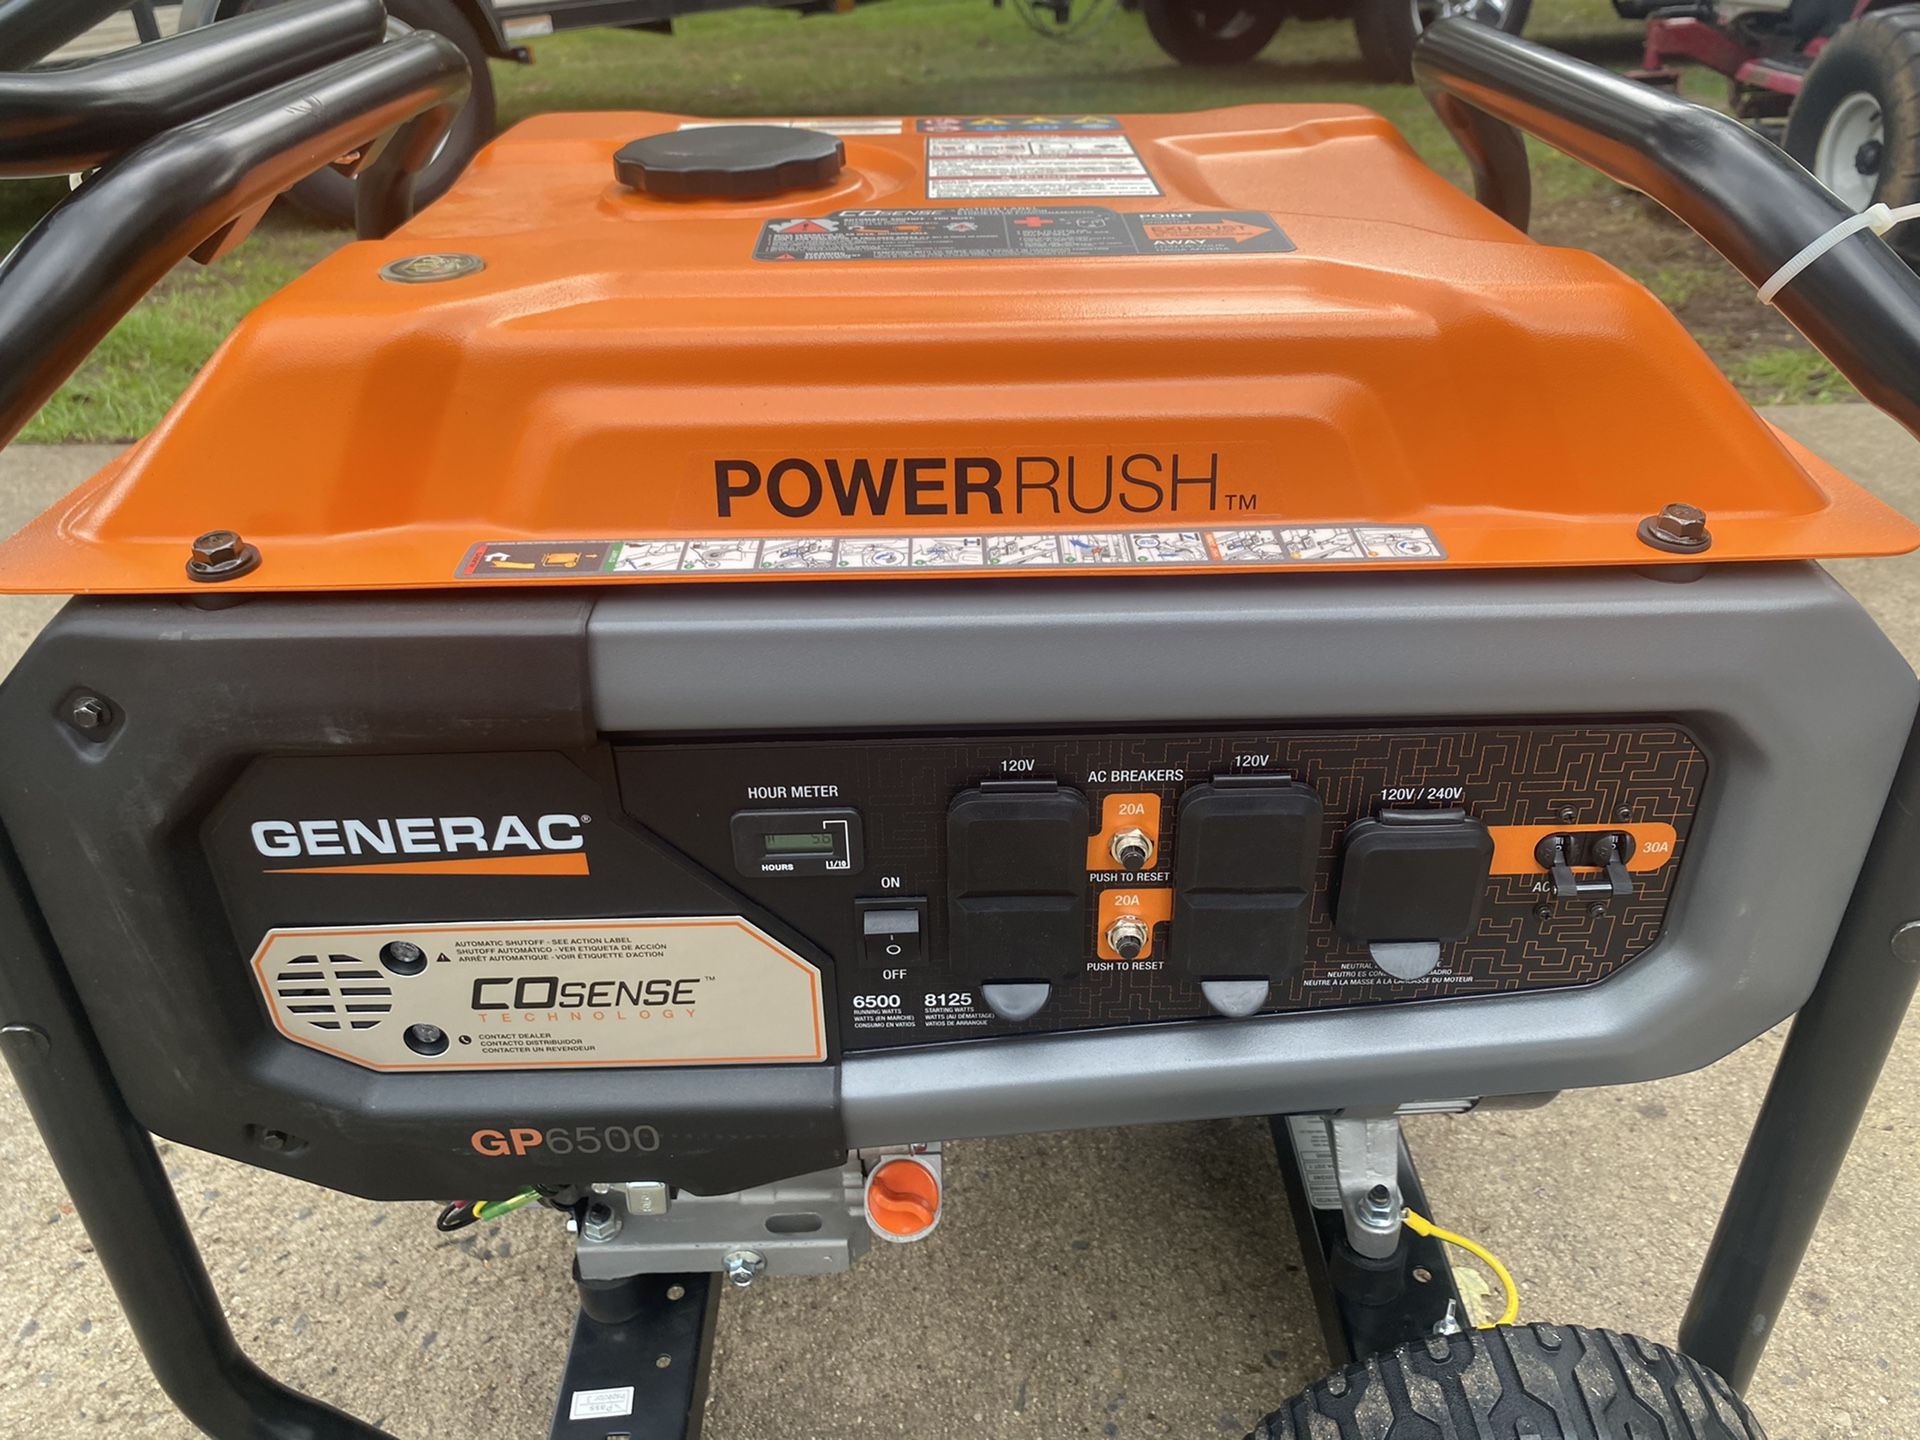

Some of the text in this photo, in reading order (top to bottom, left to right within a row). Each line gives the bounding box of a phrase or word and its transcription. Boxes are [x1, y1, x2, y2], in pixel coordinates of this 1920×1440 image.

[714, 452, 1218, 518] POWERRUSH
[1000, 759, 1036, 772] 120V
[1234, 754, 1270, 767] 120V
[1087, 769, 1184, 783] AC BREAKERS
[748, 785, 839, 799] HOUR METER
[1381, 788, 1415, 801] 120V
[1426, 786, 1463, 800] 240V
[1119, 803, 1145, 816] 20A
[251, 813, 584, 857] GENERAC
[1642, 841, 1669, 853] 30A
[761, 863, 795, 871] HOURS
[829, 860, 847, 868] 1/10
[880, 876, 900, 888] ON
[1089, 871, 1171, 882] PUSH TO RESET
[1114, 895, 1140, 906] 20A
[497, 946, 553, 954] AUTOMÁTICO
[577, 944, 620, 952] ETIQUETA
[635, 942, 667, 950] ACCIÓN
[505, 939, 544, 947] SHUTOFF
[570, 937, 603, 945] ACTION
[459, 954, 487, 962] ARRÊT
[489, 953, 549, 962] AUTOMATIQUE
[577, 951, 624, 960] ÉTIQUETTE
[625, 951, 664, 959] D'ACTION
[1086, 961, 1165, 972] PUSH TO RESET
[1341, 962, 1372, 970] NEUTRAL
[882, 968, 907, 980] OFF
[1327, 970, 1356, 978] NEUTRO
[471, 976, 701, 1010] COSENSE
[924, 992, 972, 1006] 8125
[853, 994, 901, 1008] 6500
[478, 1008, 696, 1023] TECHNOLOGY
[545, 1045, 596, 1053] REVENDEUR
[471, 1124, 660, 1157] GP6500
